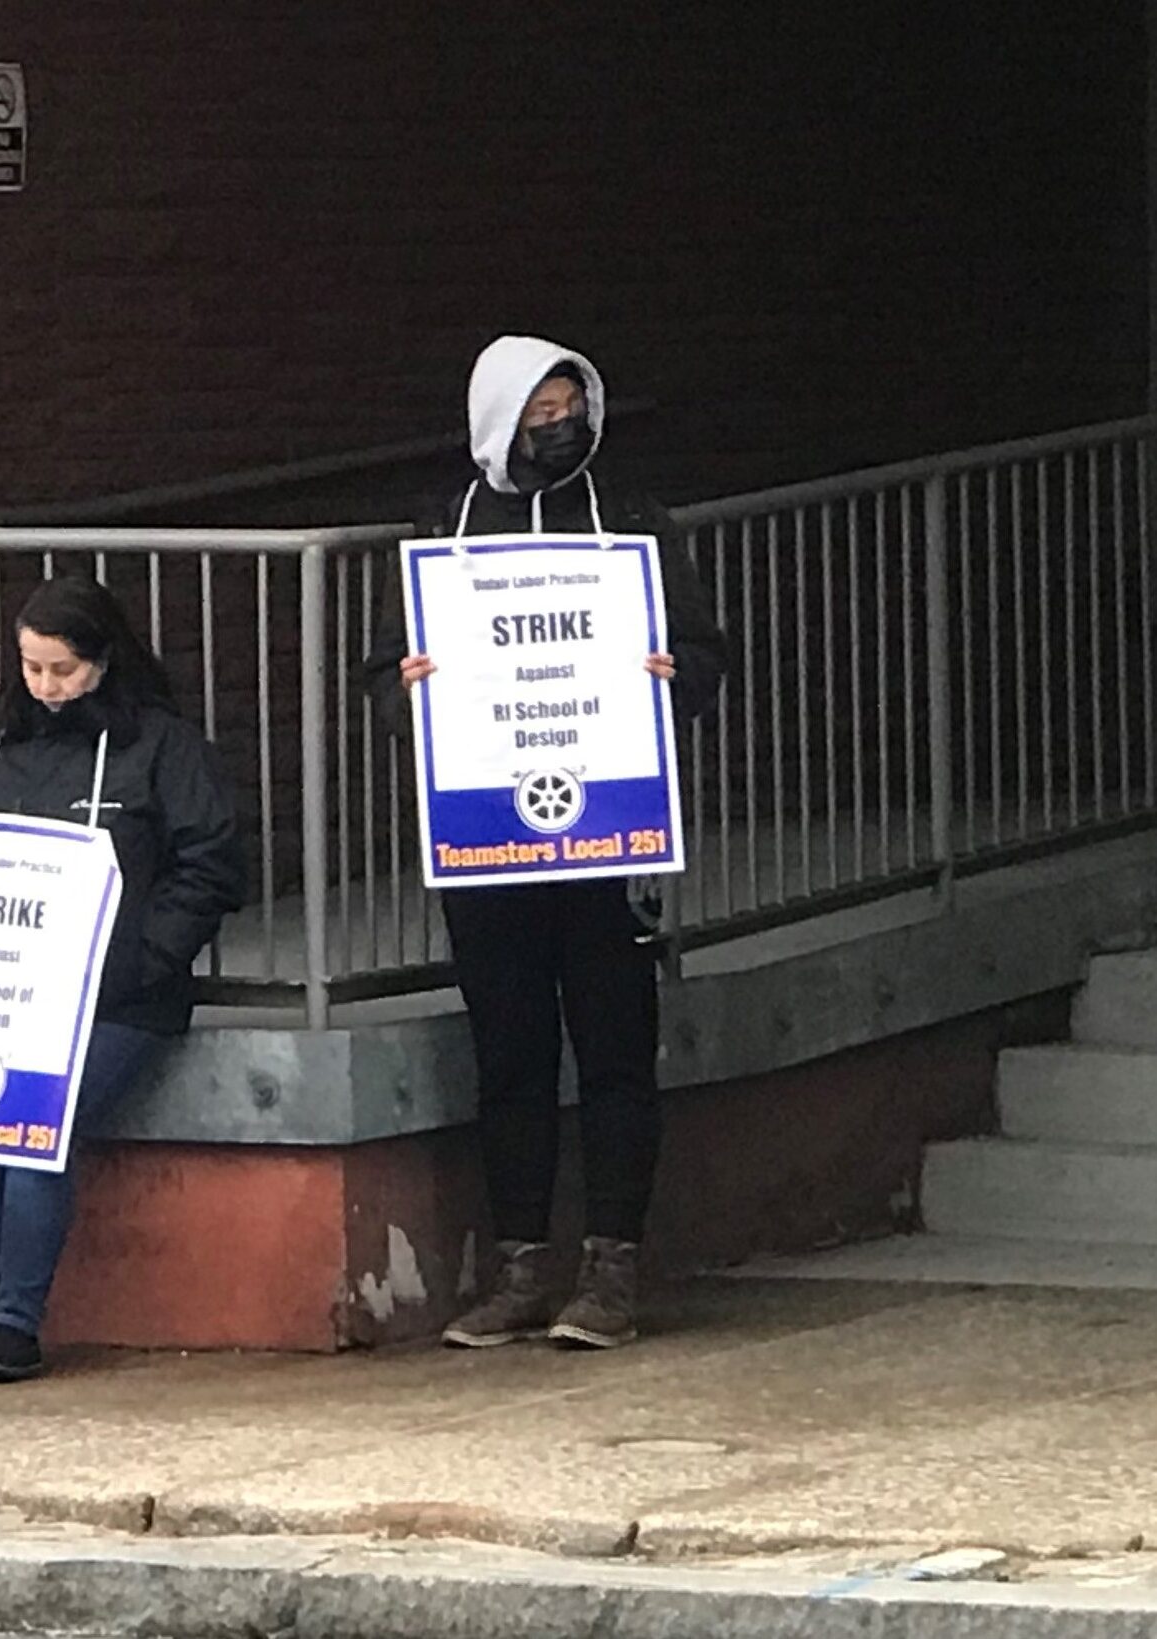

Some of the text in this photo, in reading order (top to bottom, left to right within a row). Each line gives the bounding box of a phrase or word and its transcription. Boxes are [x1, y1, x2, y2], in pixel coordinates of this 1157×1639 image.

[492, 609, 593, 647] STRIKE
[516, 664, 575, 683] Against
[493, 695, 600, 722] RI School of
[515, 728, 578, 749] Design
[436, 829, 666, 868] Teamsters Local 251
[20, 986, 34, 1004] of
[25, 1124, 57, 1151] 251
